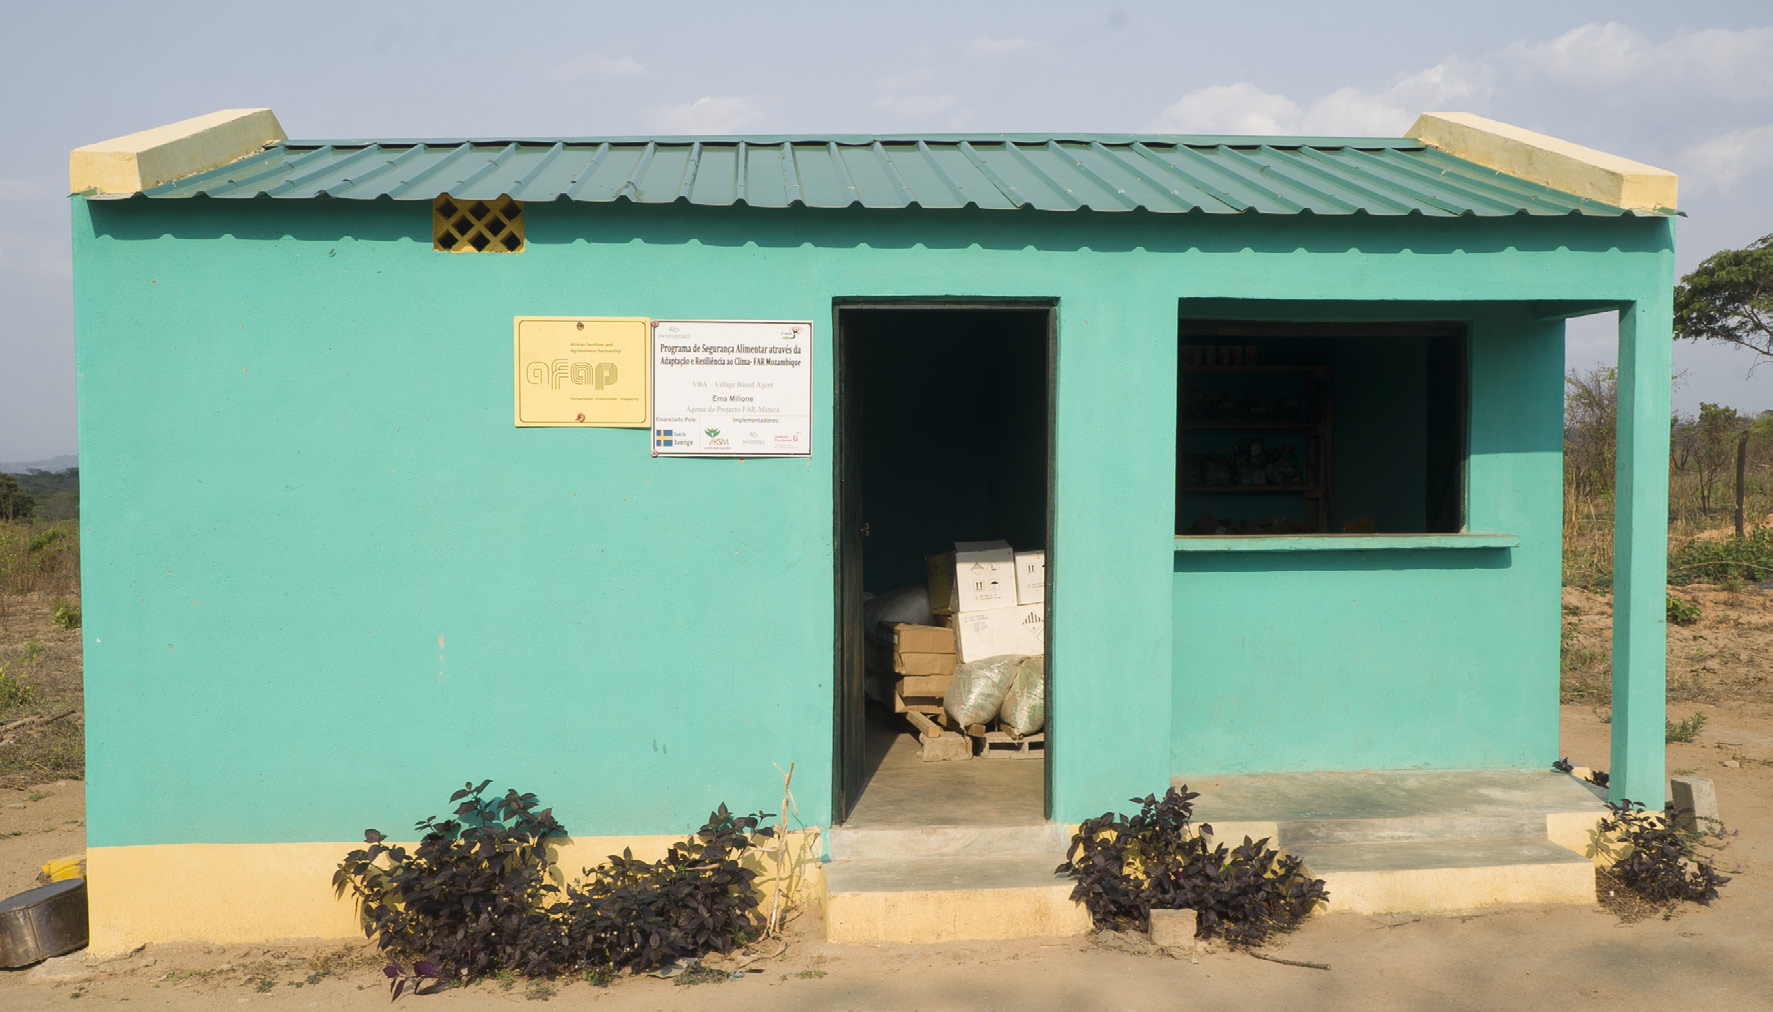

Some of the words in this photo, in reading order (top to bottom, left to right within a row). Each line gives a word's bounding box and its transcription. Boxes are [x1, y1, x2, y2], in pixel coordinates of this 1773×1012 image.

[660, 343, 691, 355] Programa
[692, 343, 700, 353] de
[702, 343, 734, 355] Segurança
[736, 343, 767, 353] Alimentar
[769, 344, 792, 354] através
[793, 344, 801, 354] da
[661, 356, 690, 367] Adaptação
[695, 356, 726, 365] Resiliência
[726, 358, 733, 366] ao
[753, 357, 764, 366] FAR
[766, 357, 801, 368] Mozambique
[526, 358, 618, 390] afap
[714, 381, 735, 390] Village
[756, 381, 774, 390] Agent
[686, 406, 706, 414] Agente
[716, 406, 741, 414] Projecto
